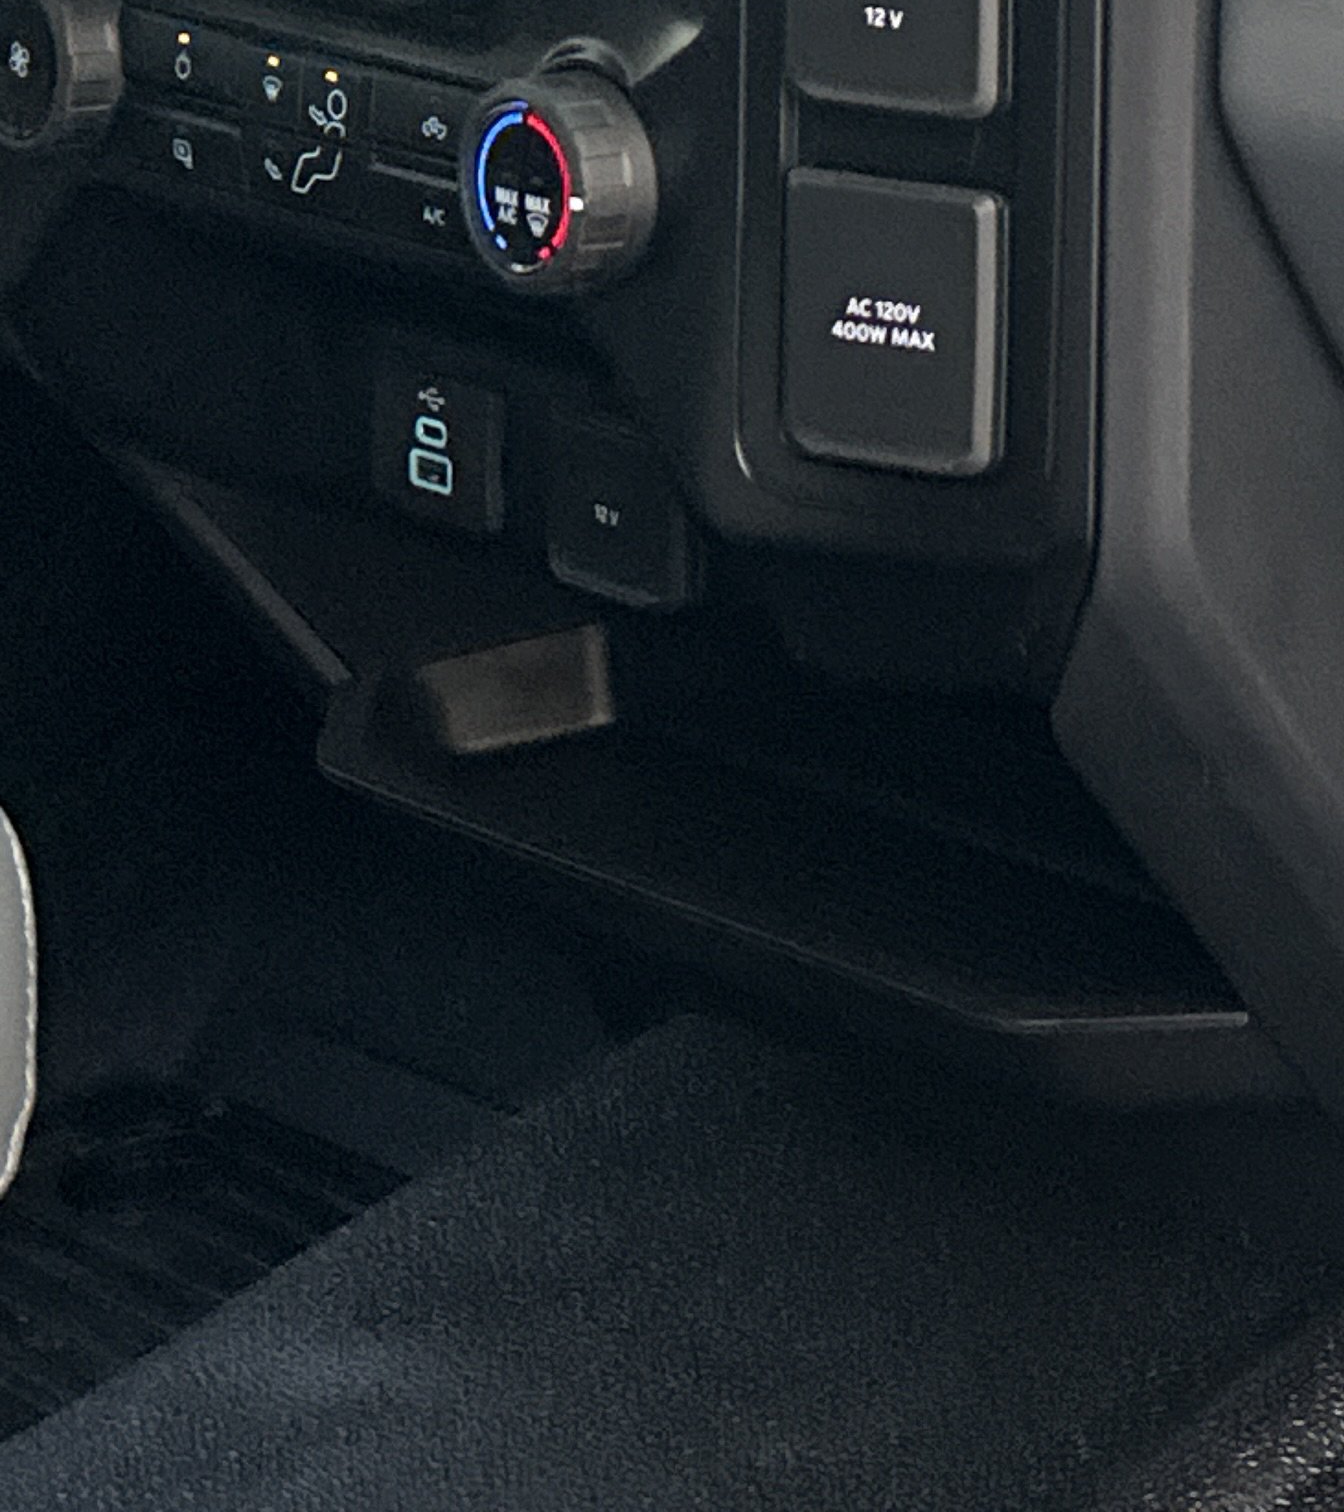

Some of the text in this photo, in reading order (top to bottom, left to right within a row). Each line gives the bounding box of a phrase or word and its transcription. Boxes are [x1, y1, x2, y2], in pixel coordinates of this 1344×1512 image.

[864, 6, 904, 30] 12 V
[845, 296, 922, 325] AC 120V
[831, 319, 936, 352] 400W MAX
